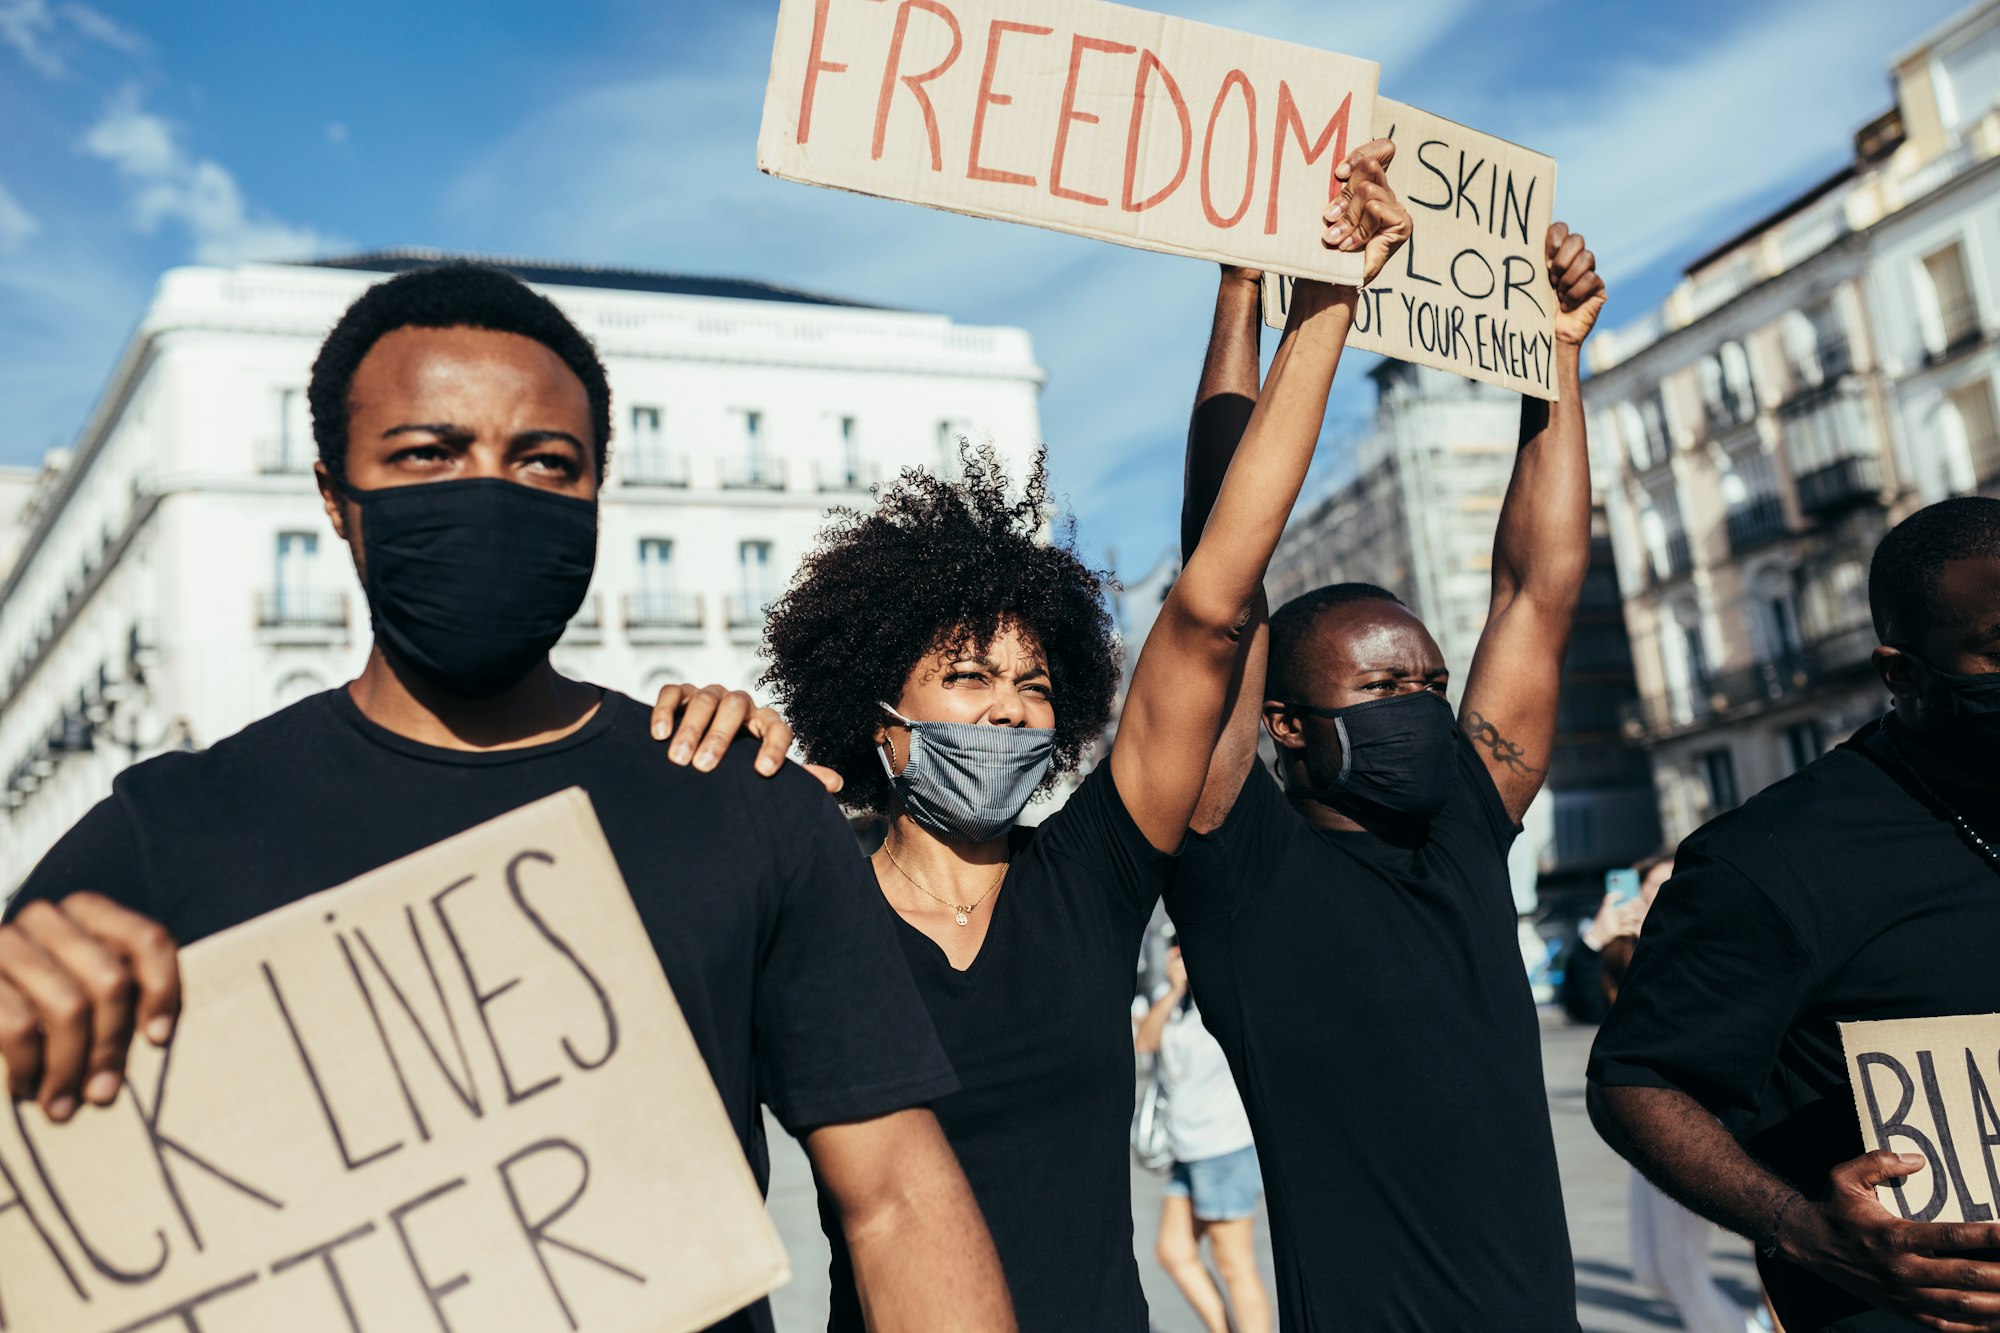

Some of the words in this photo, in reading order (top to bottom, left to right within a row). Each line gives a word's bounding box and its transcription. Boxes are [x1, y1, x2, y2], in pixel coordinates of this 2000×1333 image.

[796, 0, 1352, 235] FREEDOM
[1407, 140, 1537, 245] SKIN
[1400, 292, 1474, 366] YOUR
[1475, 313, 1553, 390] ENEMY
[1856, 1047, 2000, 1224] BLA
